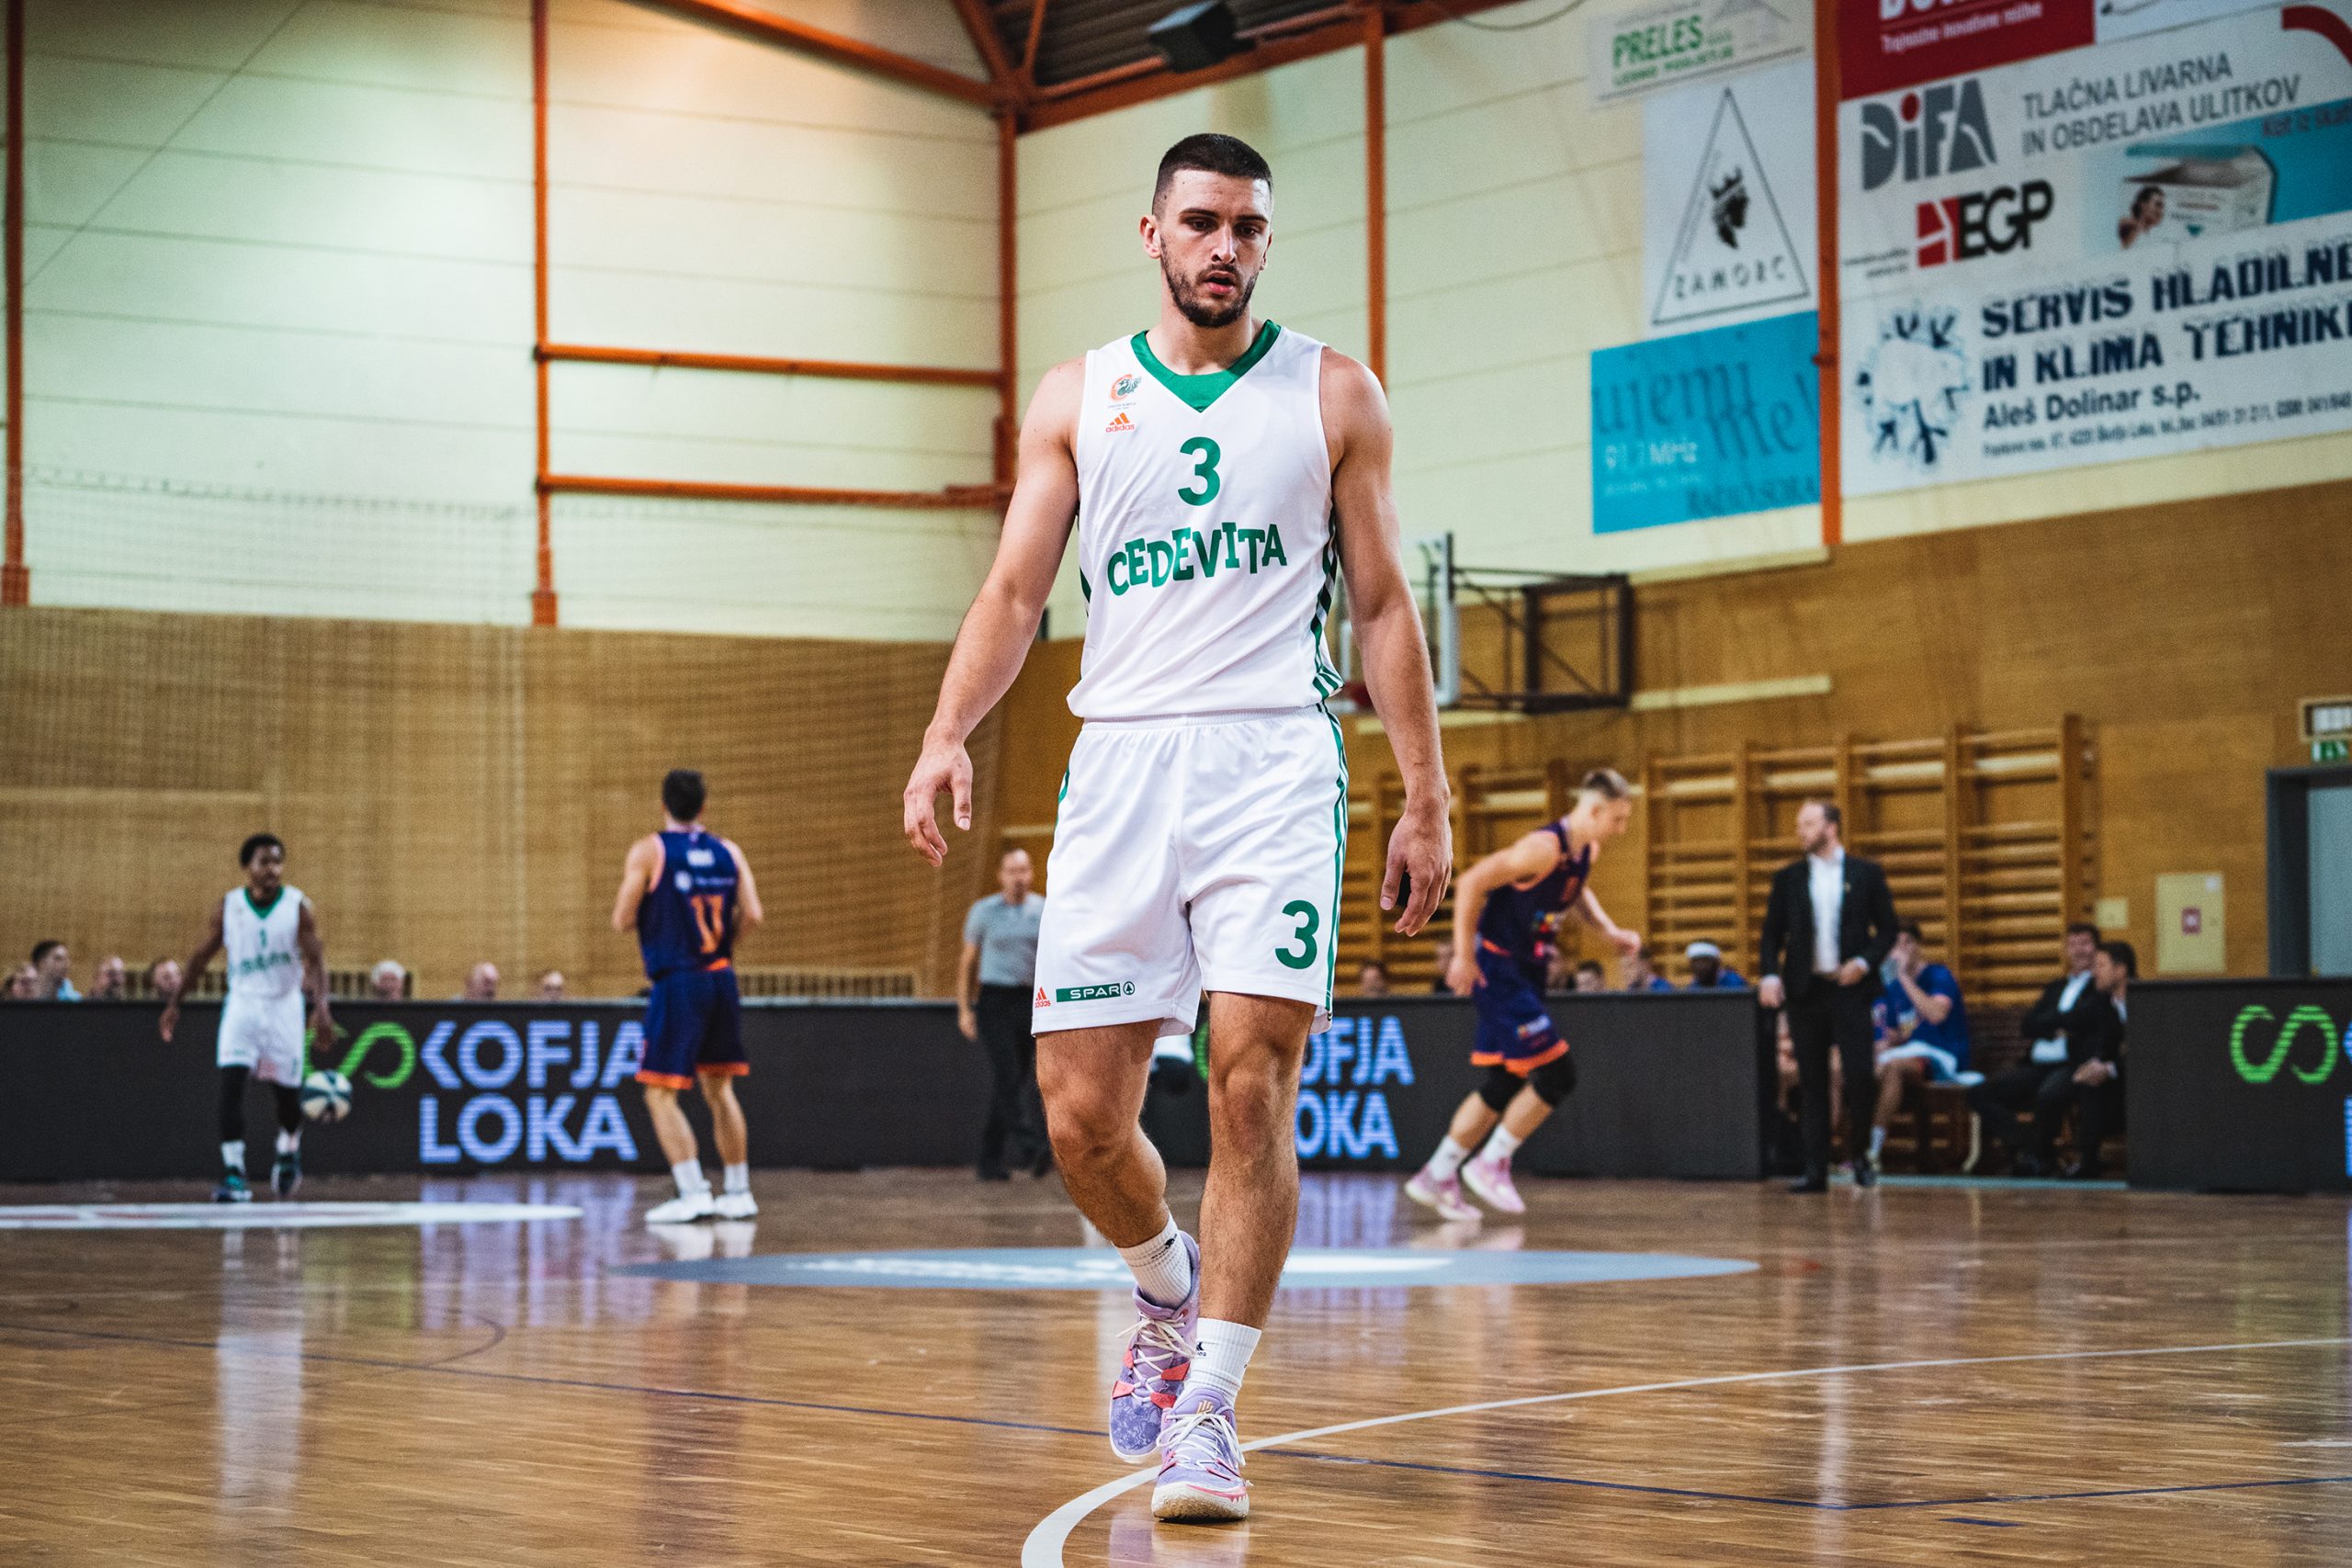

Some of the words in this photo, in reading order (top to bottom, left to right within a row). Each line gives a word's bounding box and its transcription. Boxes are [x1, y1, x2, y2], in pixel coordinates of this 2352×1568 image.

[1612, 15, 1702, 68] PRELES
[2022, 75, 2119, 119] TLAČNA
[2124, 53, 2233, 97] LIVARNA
[2023, 127, 2046, 155] IN
[2052, 101, 2184, 151] OBDELAVA
[2189, 75, 2301, 122] ULITKOV
[1958, 180, 2054, 259] EGP
[1981, 279, 2133, 337] SERVIS
[1983, 353, 2017, 391] IN
[2035, 332, 2164, 383] KLIMA
[2184, 301, 2352, 360] TEHNIK
[1105, 423, 1136, 433] adidas
[1983, 401, 2037, 430] Aleš
[2047, 387, 2141, 419] Dolinar
[2152, 380, 2201, 409] s.p.
[1178, 436, 1221, 506] 3
[1107, 522, 1287, 596] CEDEVITA
[1275, 900, 1319, 969] 3
[1069, 985, 1120, 999] SPAR
[419, 1093, 639, 1163] LOKA
